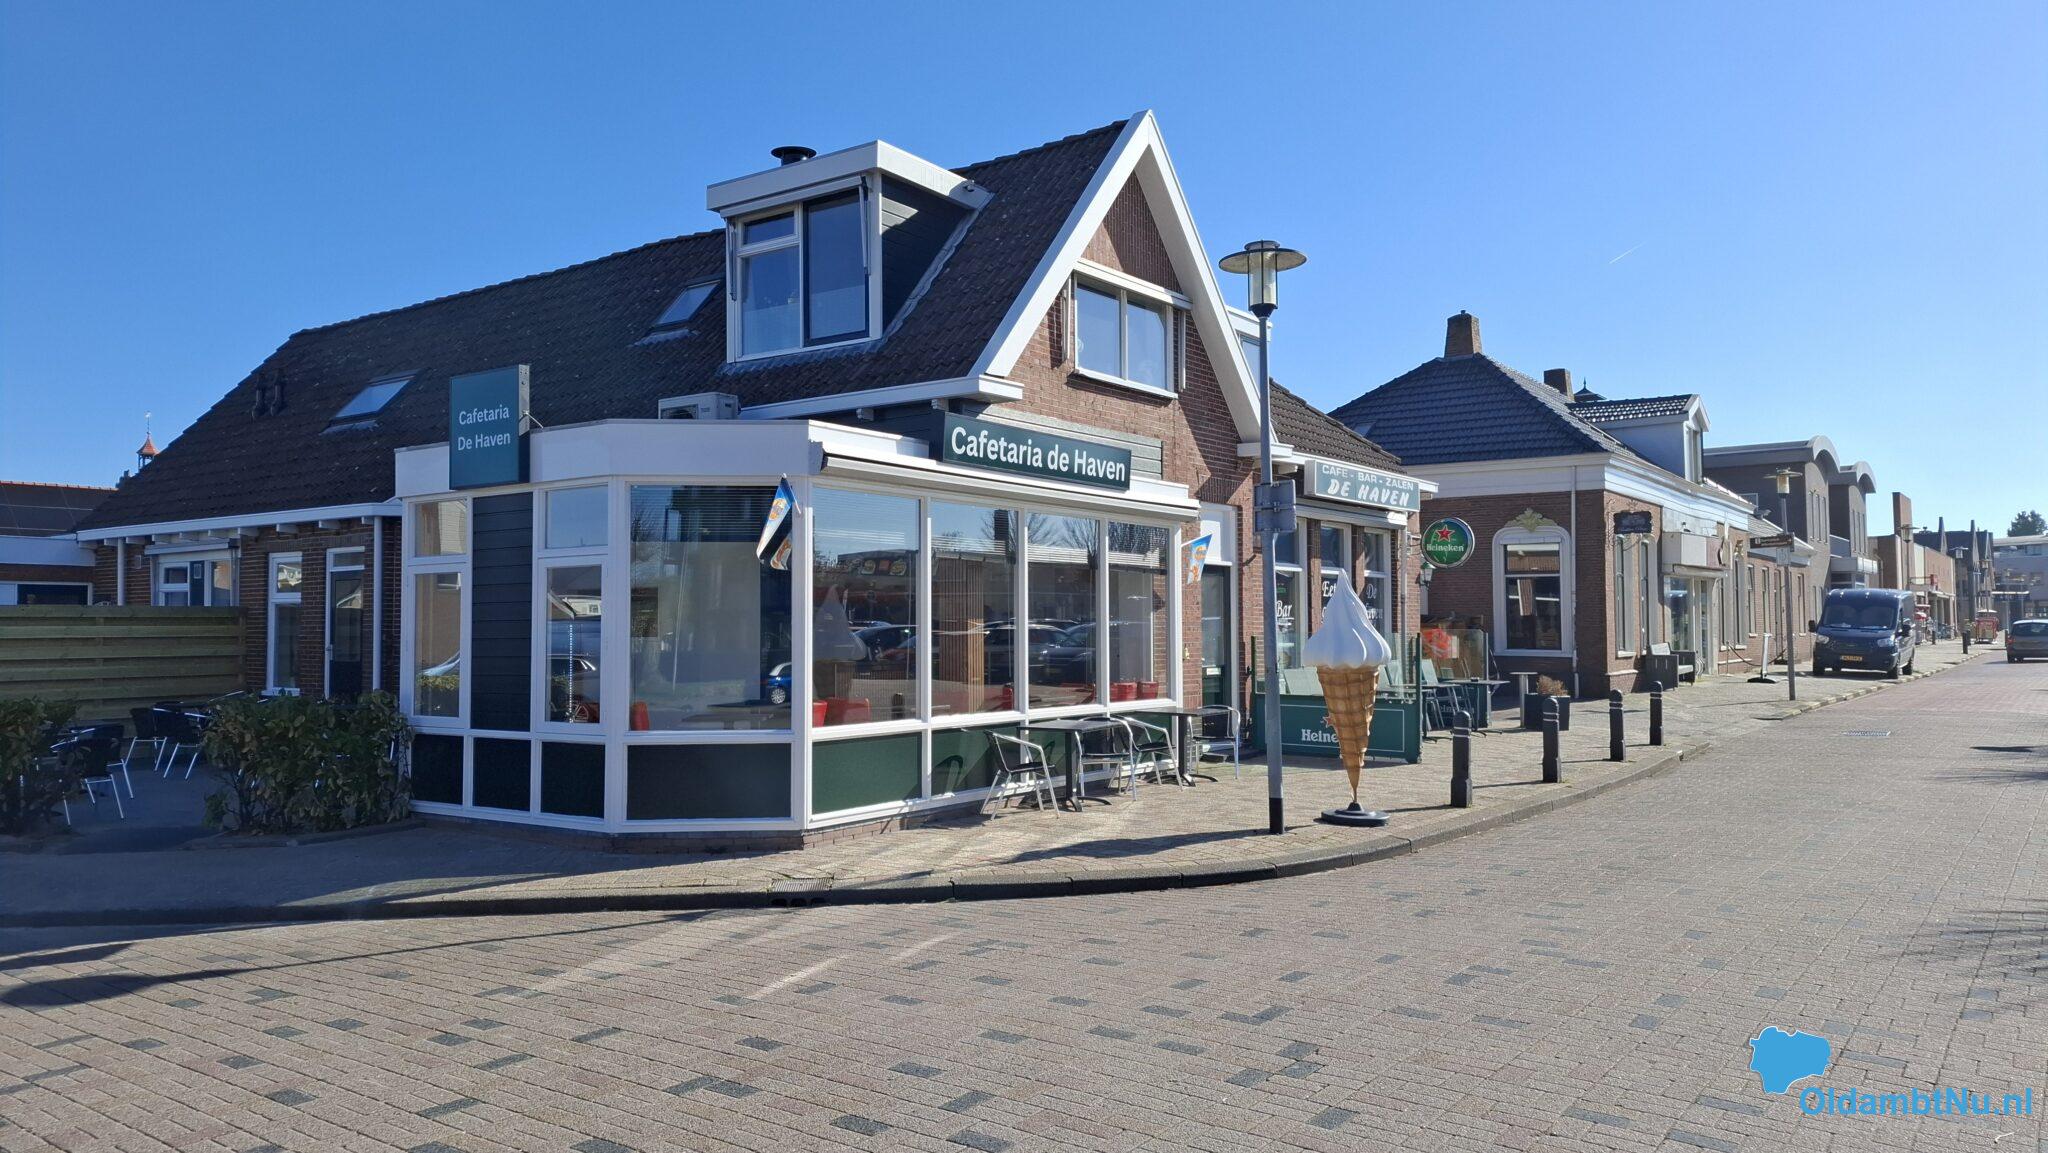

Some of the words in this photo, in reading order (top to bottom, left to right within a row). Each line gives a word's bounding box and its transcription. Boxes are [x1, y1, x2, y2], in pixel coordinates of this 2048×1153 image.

[459, 404, 510, 425] Cafetaria
[458, 436, 473, 451] De
[475, 433, 511, 449] Haven
[951, 426, 1043, 468] Cafetaria
[1047, 444, 1069, 472] de
[1074, 450, 1126, 482] Haven
[1358, 472, 1378, 485] BAR
[1385, 477, 1414, 492] ZALEN
[1327, 478, 1352, 497] DE
[1357, 484, 1410, 507] HAVEN
[1426, 543, 1465, 552] Heineken
[1276, 600, 1293, 618] Bar
[1301, 728, 1339, 743] Heine
